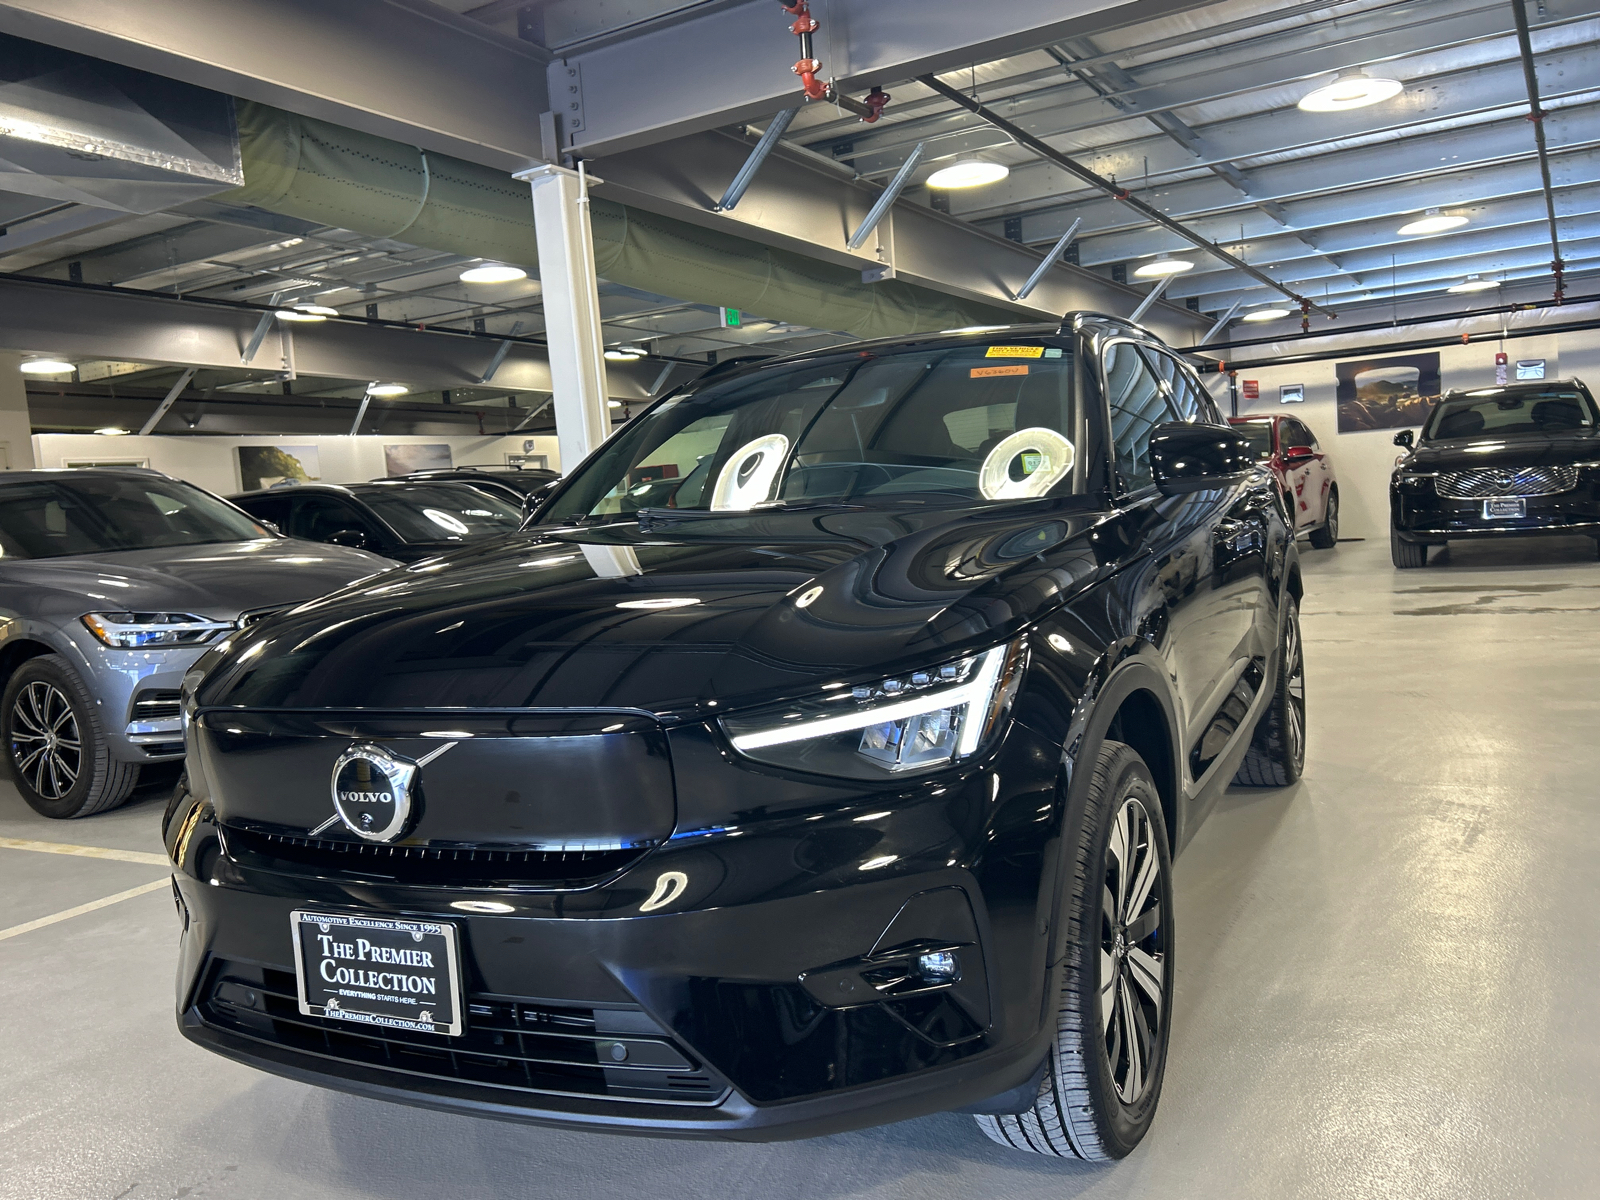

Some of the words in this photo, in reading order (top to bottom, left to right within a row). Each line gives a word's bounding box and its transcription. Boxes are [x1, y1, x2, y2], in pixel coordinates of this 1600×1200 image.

[340, 791, 392, 803] VOLVO
[302, 913, 348, 925] AUTOMOTIVE
[348, 917, 395, 929] EXCELLENCE
[395, 921, 418, 931] SINCE
[420, 924, 441, 934] 1995
[317, 934, 356, 961] THE
[356, 938, 435, 968] PREMIER
[319, 958, 436, 995] COLLECTION
[338, 988, 376, 1000] EVERYTHING
[376, 993, 399, 1003] STARTS
[399, 997, 418, 1005] HERE.
